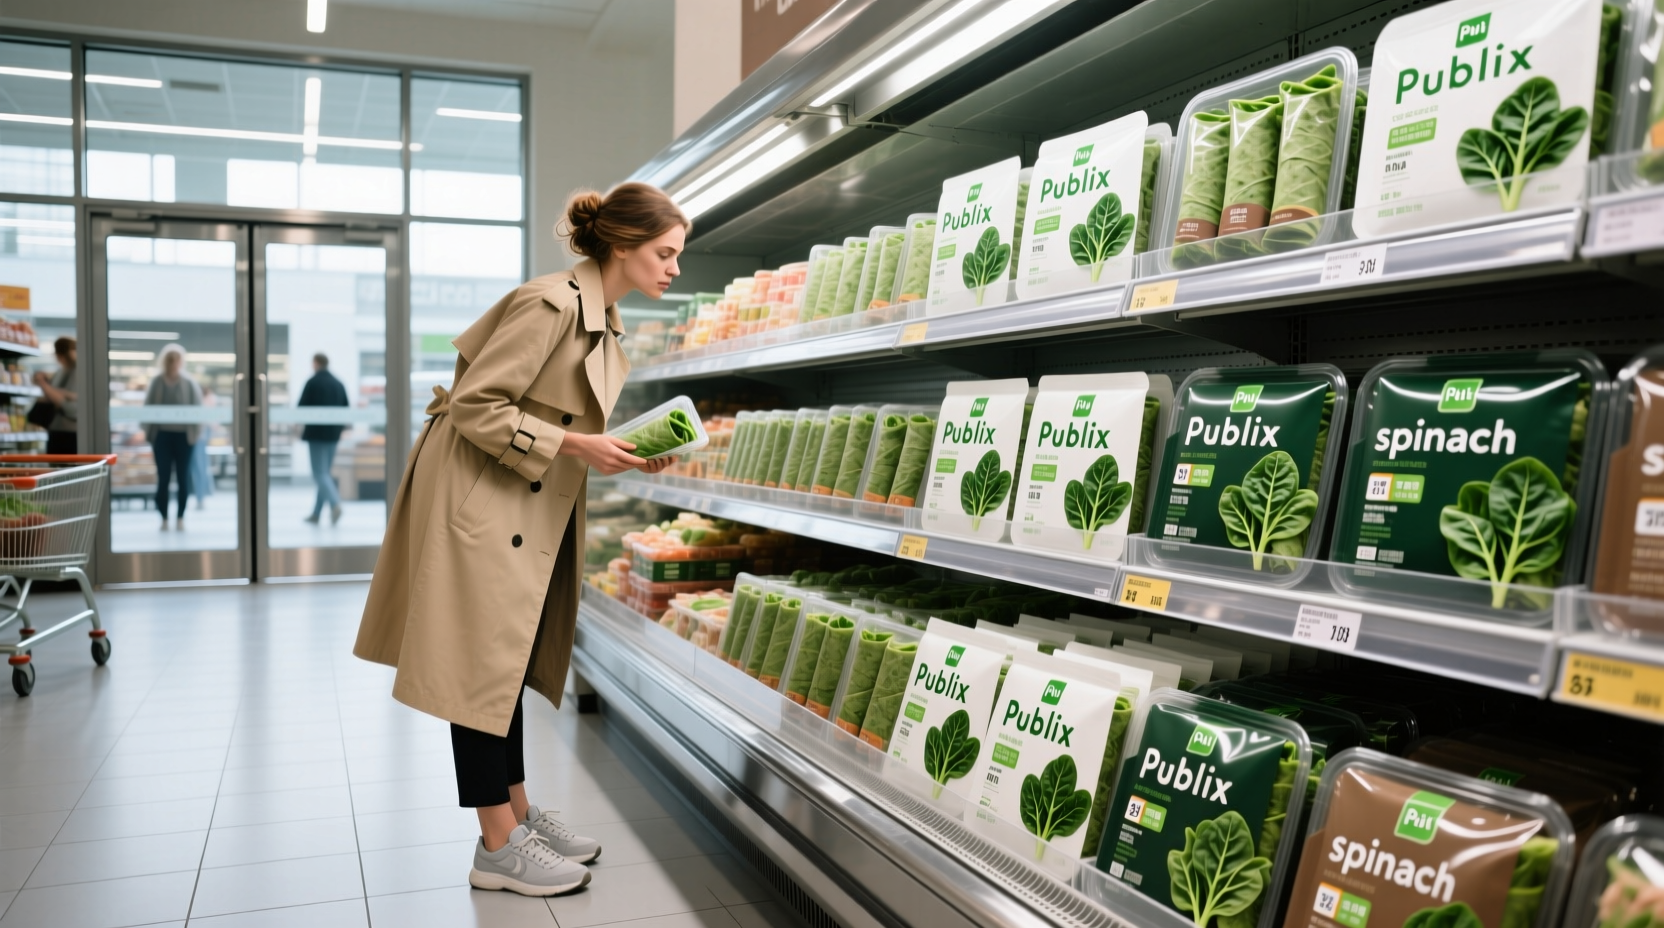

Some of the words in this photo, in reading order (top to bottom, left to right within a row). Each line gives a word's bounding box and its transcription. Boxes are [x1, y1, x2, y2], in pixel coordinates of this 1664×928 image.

[1396, 43, 1534, 105] Publix
[1040, 166, 1111, 203] Publix
[942, 202, 993, 233] Publix
[943, 420, 996, 445] Publix
[1038, 421, 1110, 449] Publix
[1185, 416, 1281, 447] Publix
[1374, 418, 1517, 460] spinach
[914, 662, 970, 704] Publix
[1002, 699, 1075, 747] Publix
[1138, 748, 1233, 805] Publix
[1328, 836, 1456, 902] spinach
